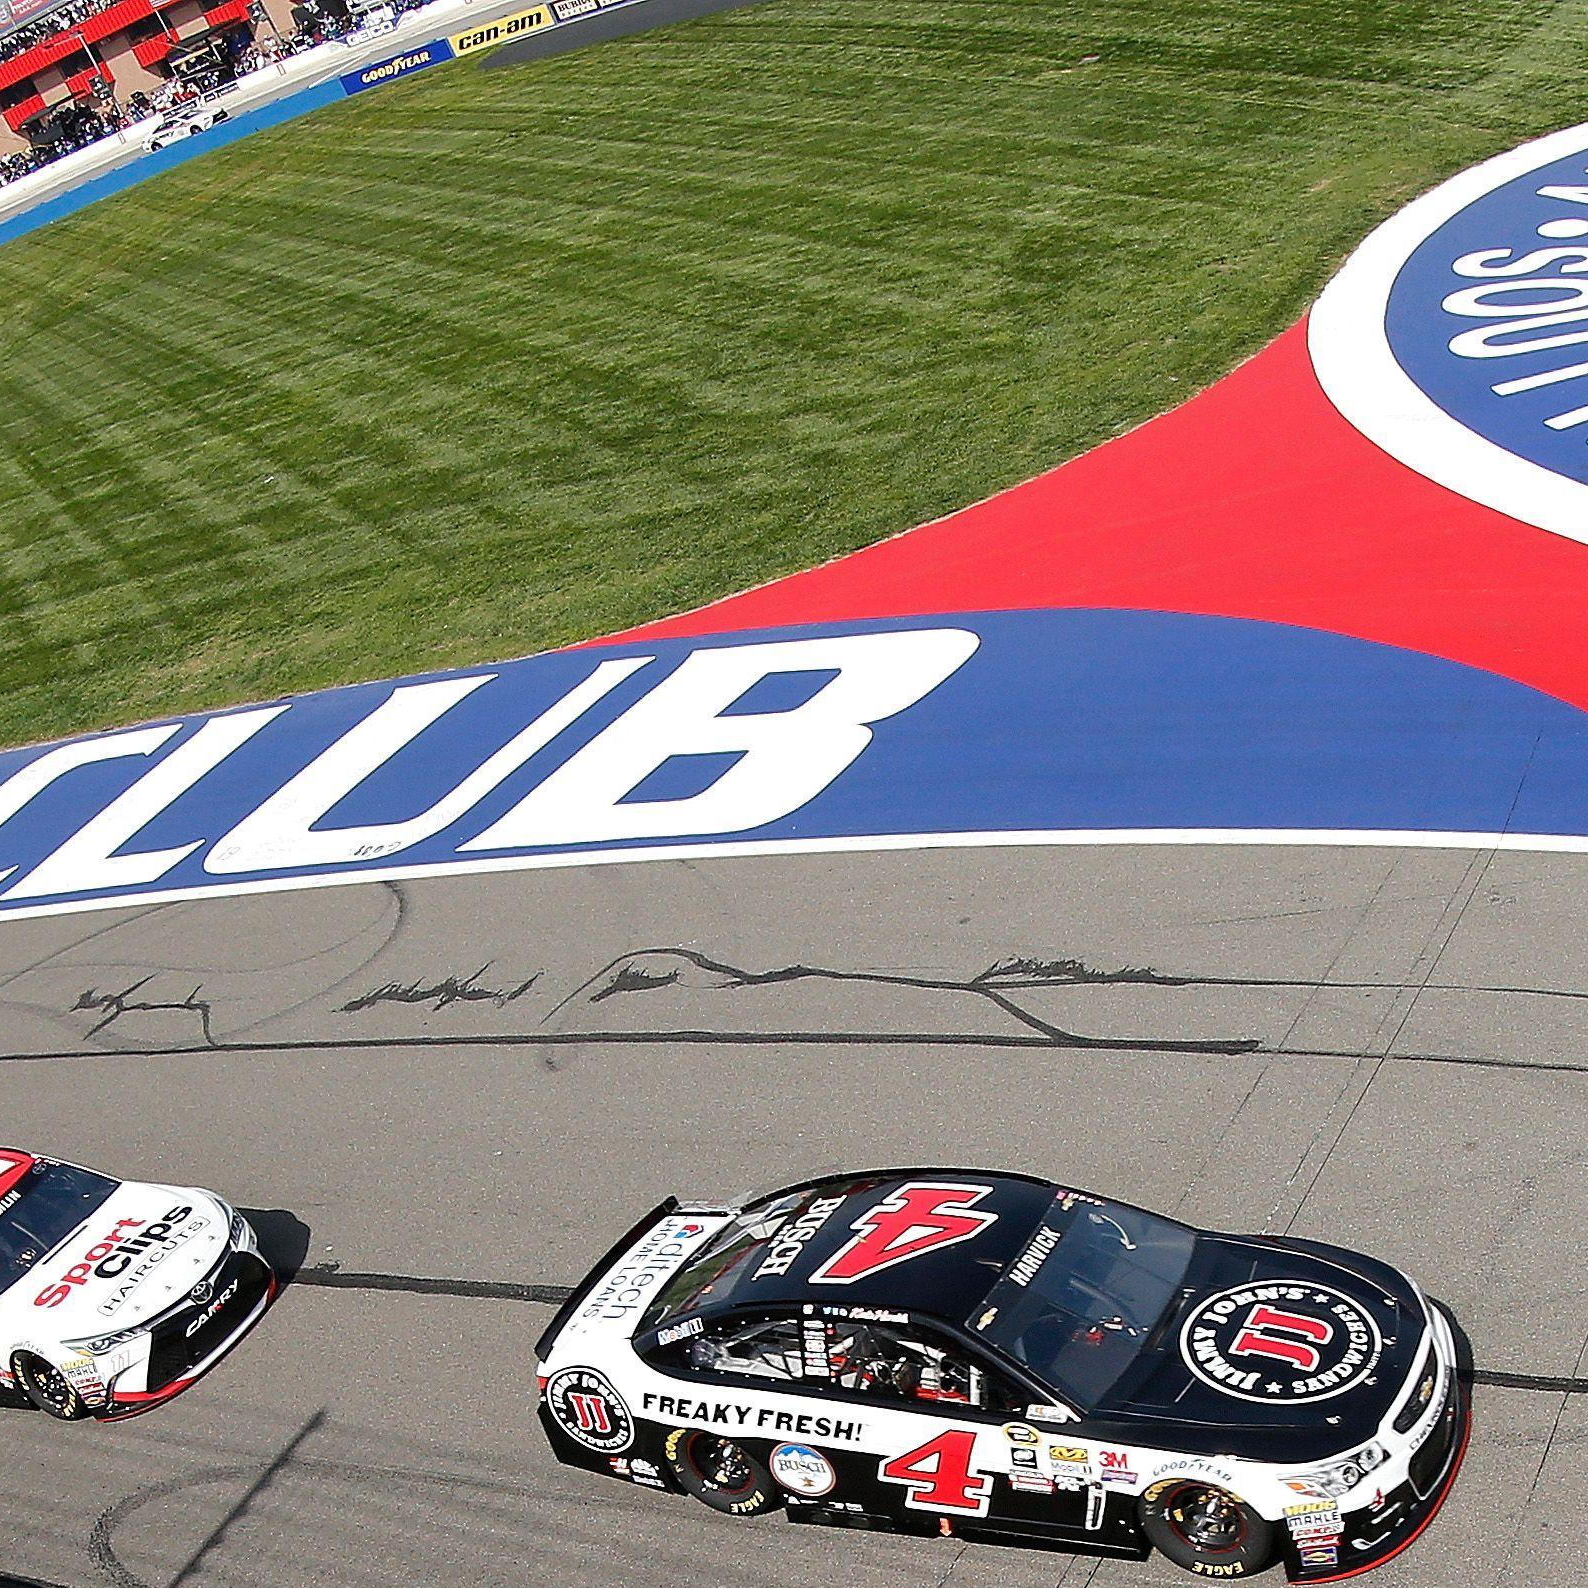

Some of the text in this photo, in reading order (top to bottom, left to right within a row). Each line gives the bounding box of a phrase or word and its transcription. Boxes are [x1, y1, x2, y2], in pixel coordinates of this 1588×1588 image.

[458, 11, 543, 51] can-am
[360, 50, 431, 84] GOODYEAR
[33, 1216, 147, 1309] Sport
[93, 1204, 194, 1280] Clips
[102, 1219, 204, 1312] HAIRCUTS
[752, 1193, 849, 1281] BUSCH
[808, 1181, 999, 1285] 4
[1008, 1225, 1061, 1287] HARVICK
[186, 1278, 239, 1338] CAMRY
[582, 1266, 631, 1319] LOANS
[603, 1242, 684, 1319] ditech
[1192, 1286, 1311, 1391] JIMMY JOHN'S
[1228, 1303, 1334, 1373] JJ
[1291, 1303, 1369, 1394] SANDWICHES
[643, 1392, 866, 1442] FREAKY FRESH!
[778, 1458, 827, 1475] BUSCH
[878, 1427, 991, 1518] 4
[1098, 1450, 1129, 1470] 3M
[1287, 1511, 1342, 1529] MAHLE
[1191, 1560, 1245, 1577] EAGLE
